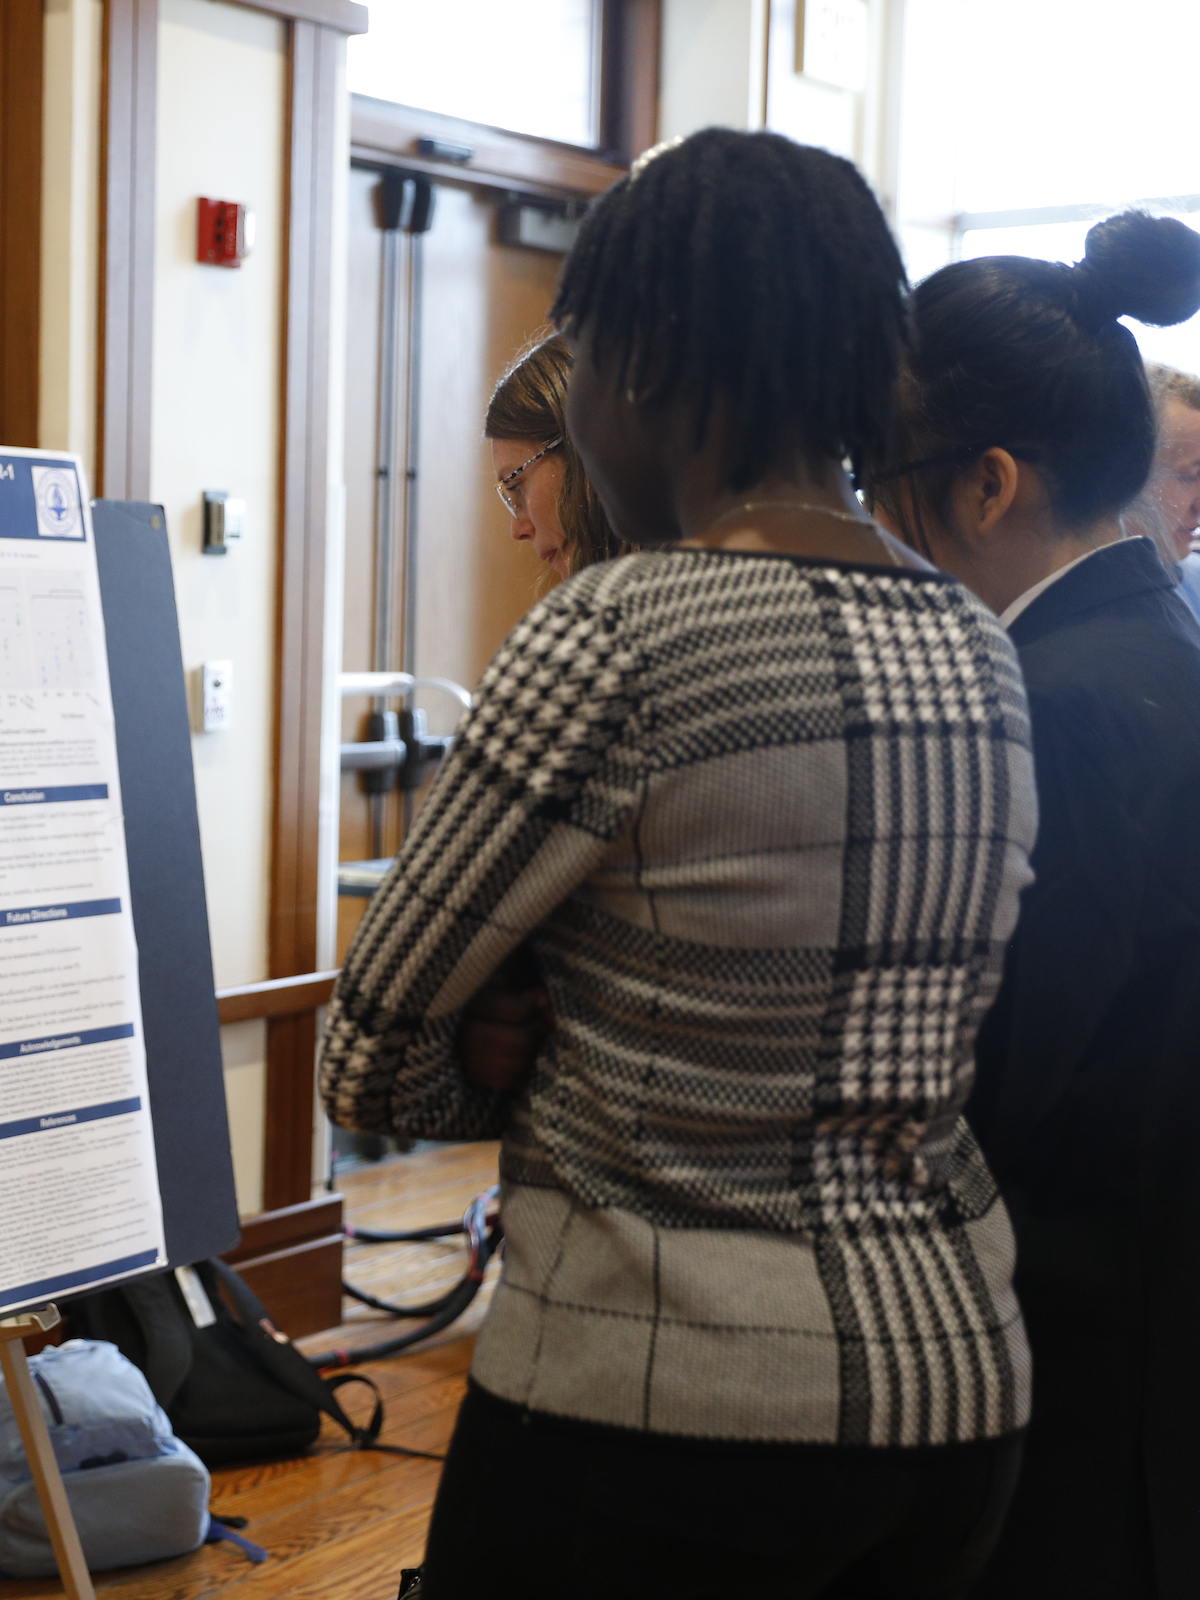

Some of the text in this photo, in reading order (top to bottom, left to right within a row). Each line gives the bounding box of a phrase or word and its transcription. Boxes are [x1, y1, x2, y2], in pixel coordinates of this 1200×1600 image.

[4, 791, 45, 803] Conclusion
[6, 908, 68, 923] Future Directions
[20, 1036, 81, 1053] Acknowledgements
[40, 1114, 77, 1128] References
